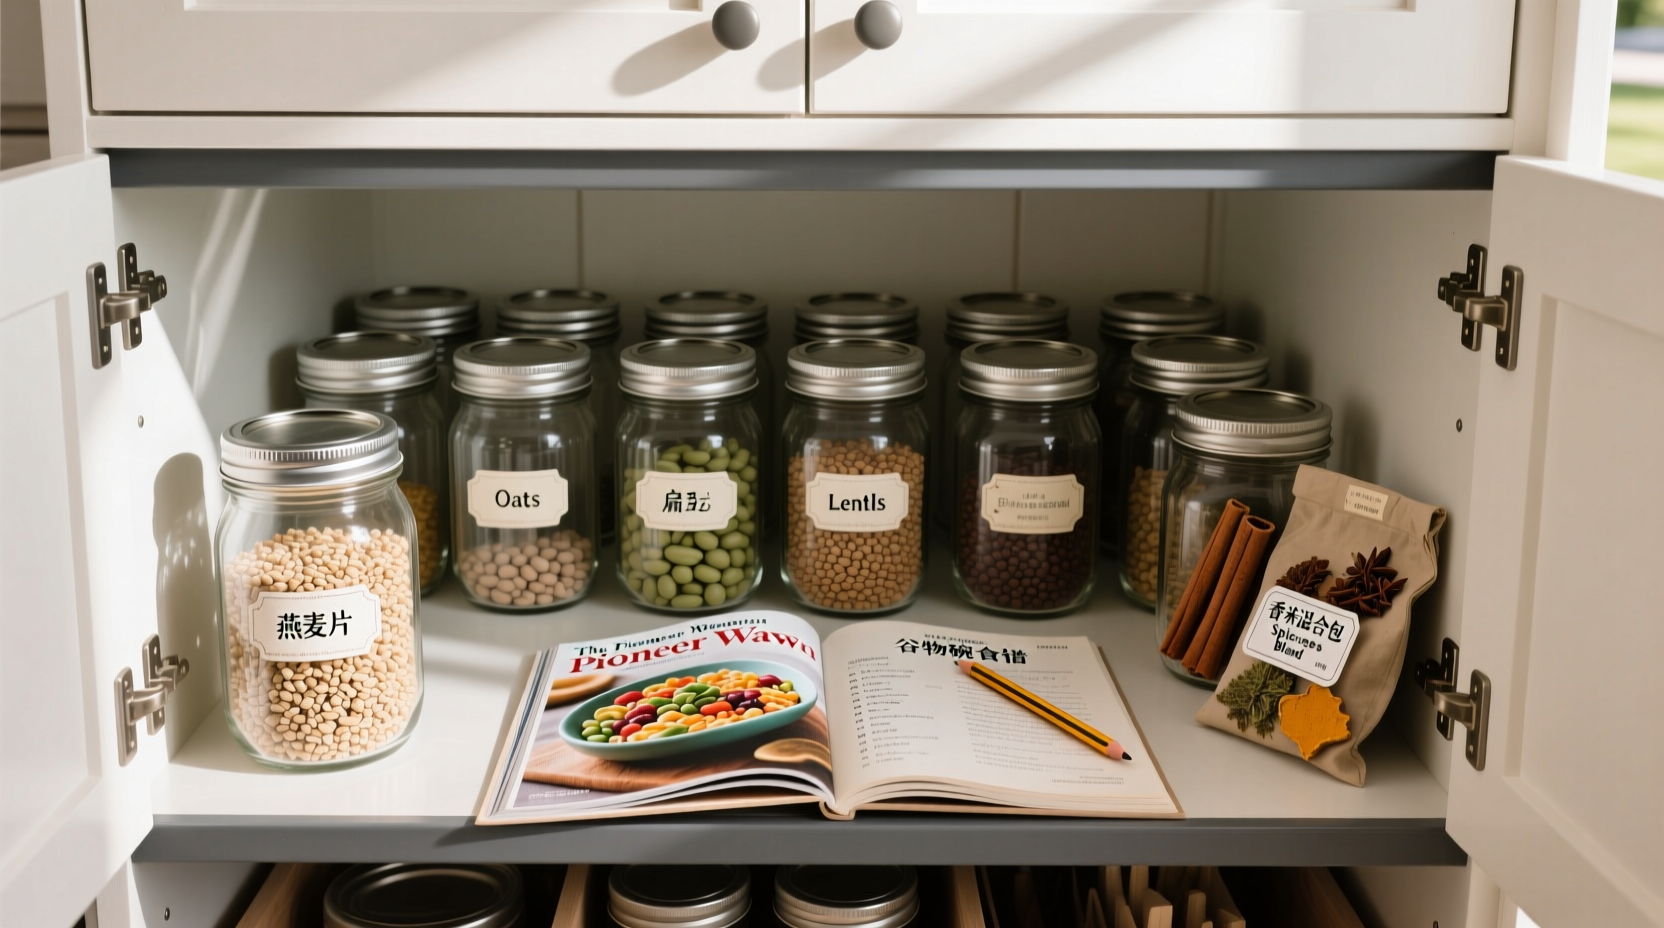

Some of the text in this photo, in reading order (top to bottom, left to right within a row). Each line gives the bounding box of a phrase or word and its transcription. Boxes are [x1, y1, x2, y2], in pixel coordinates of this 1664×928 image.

[495, 489, 541, 508] Oats
[829, 493, 886, 512] Lentls
[276, 609, 353, 640] 燕麦片
[570, 636, 707, 674] Pioneer
